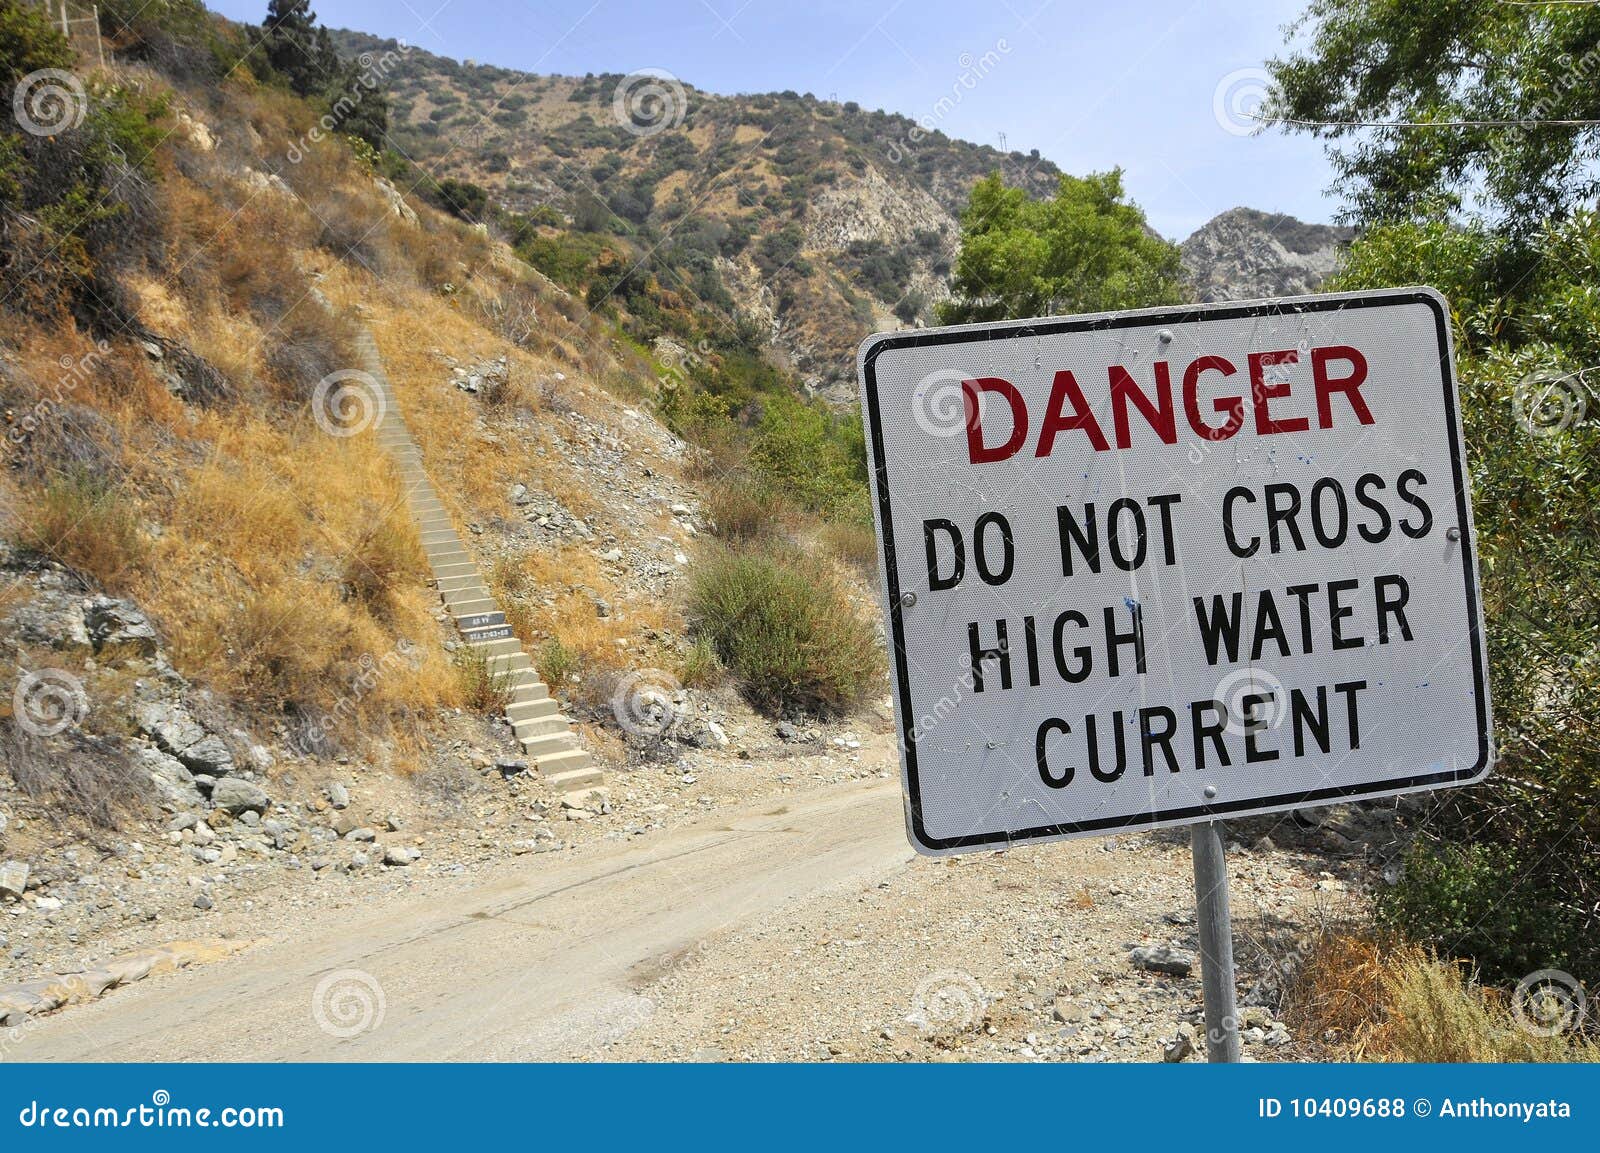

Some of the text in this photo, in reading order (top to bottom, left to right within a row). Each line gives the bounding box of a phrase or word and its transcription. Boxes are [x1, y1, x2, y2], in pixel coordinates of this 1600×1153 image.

[961, 346, 1375, 464] DANGER
[922, 468, 1433, 592] DO NOT CROSS
[967, 573, 1414, 694] HIGH WATER
[1035, 679, 1368, 790] CURRENT
